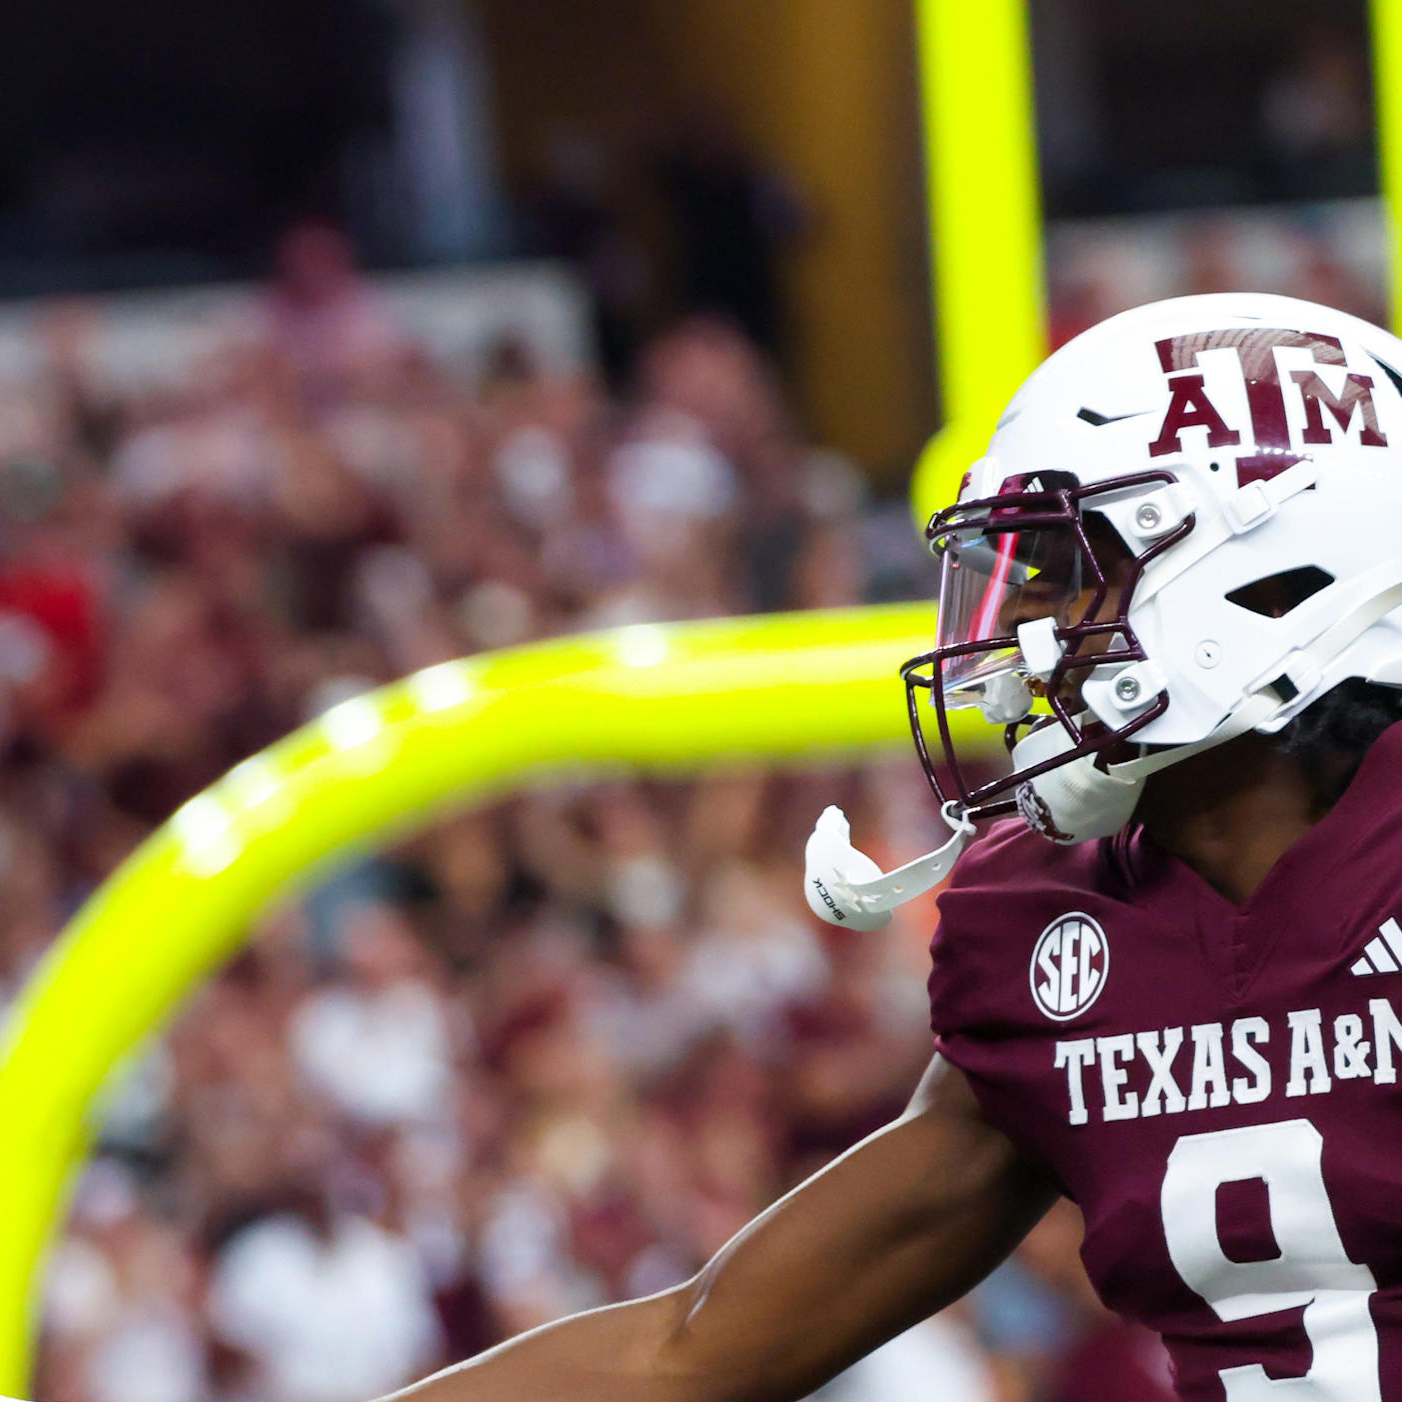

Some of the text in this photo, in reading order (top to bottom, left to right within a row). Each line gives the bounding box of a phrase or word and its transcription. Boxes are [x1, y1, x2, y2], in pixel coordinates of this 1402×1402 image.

[813, 877, 846, 921] SHOCK
[1039, 920, 1102, 1013] SEC
[1054, 1016, 1271, 1125] TEXAS
